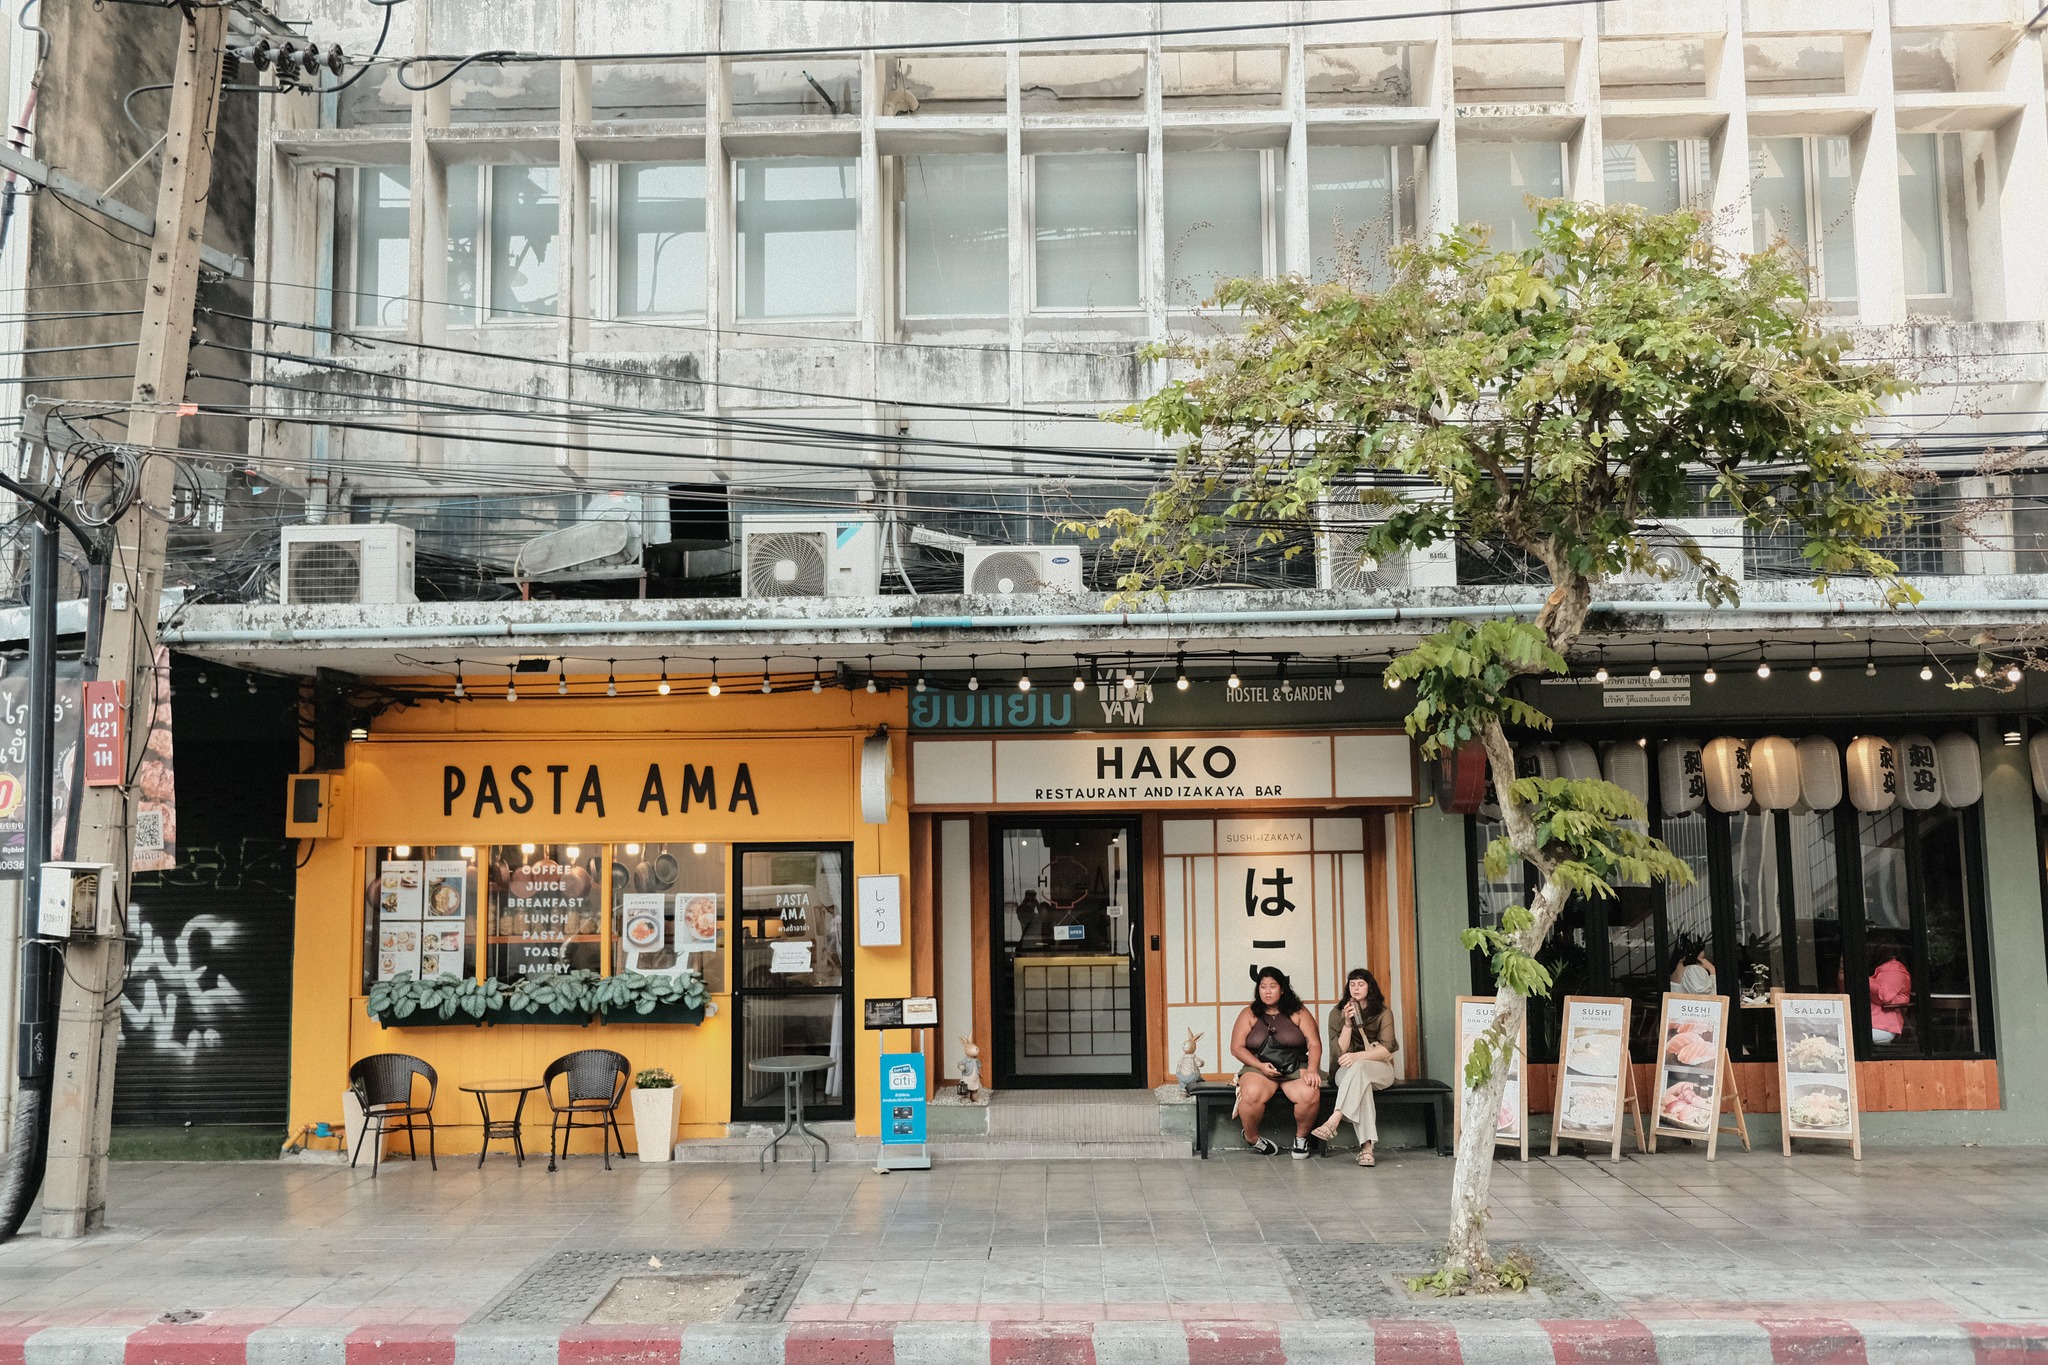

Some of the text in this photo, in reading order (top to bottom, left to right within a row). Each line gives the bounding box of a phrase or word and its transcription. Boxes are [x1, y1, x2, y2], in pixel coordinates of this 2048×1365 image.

[1711, 526, 1736, 535] beko
[911, 673, 1072, 728] ยิมแยม
[1226, 686, 1332, 703] HOSTEL & GARDEN
[92, 702, 115, 719] KP
[1100, 701, 1145, 726] YAM
[88, 720, 118, 738] 421
[93, 750, 113, 767] 1H
[1096, 745, 1237, 780] HAKO
[443, 762, 761, 819] PASTA AMA
[1035, 785, 1283, 800] RESTAURANT AND IZAKAYA BAR
[1226, 832, 1303, 843] SUSHI-IZAKAYA
[521, 864, 572, 875] COFFEE
[525, 881, 567, 892] JUICE
[507, 897, 584, 908] BREAKFAST
[776, 892, 810, 907] PASTA
[779, 907, 807, 921] AMA
[875, 889, 886, 932] しゃり
[524, 914, 569, 924] LUNCH
[522, 930, 565, 941] PASTA
[523, 947, 567, 957] TOAST
[518, 963, 571, 974] BAKERY
[1581, 1008, 1612, 1016] SUSHI
[1681, 1005, 1711, 1014] SUSHI
[1794, 1007, 1831, 1015] SALAD
[893, 1074, 910, 1086] citi
